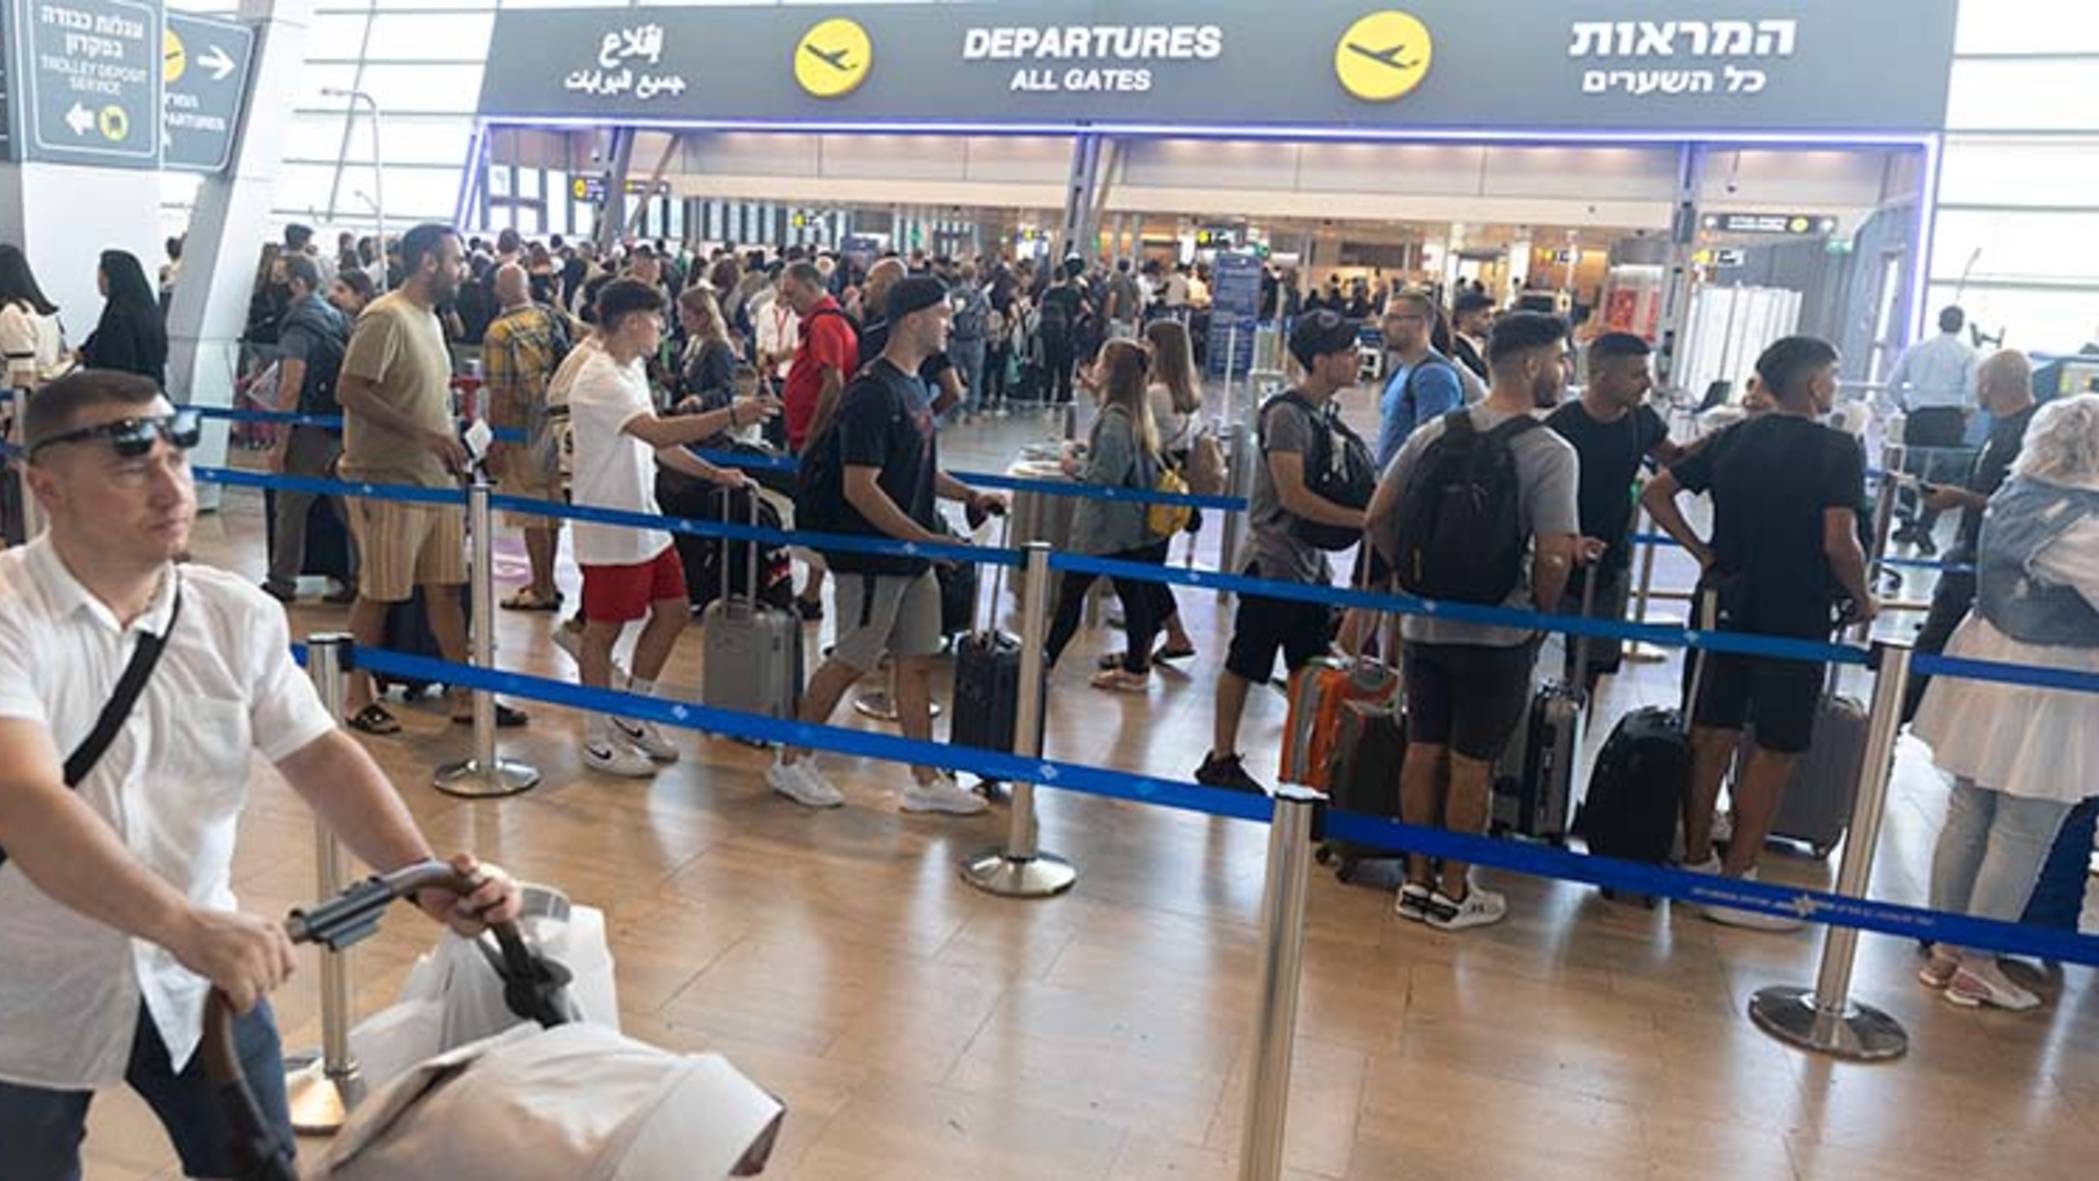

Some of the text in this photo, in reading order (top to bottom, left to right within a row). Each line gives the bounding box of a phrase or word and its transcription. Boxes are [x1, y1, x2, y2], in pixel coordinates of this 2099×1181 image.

[963, 25, 1222, 59] DEPARTURES
[1569, 19, 1797, 56] המראות
[42, 54, 95, 75] TROLLEY
[564, 68, 686, 99] جميع البوابات
[1010, 69, 1152, 91] ALL GATES
[1582, 65, 1766, 94] כל השערים
[162, 111, 225, 131] PARTURES
